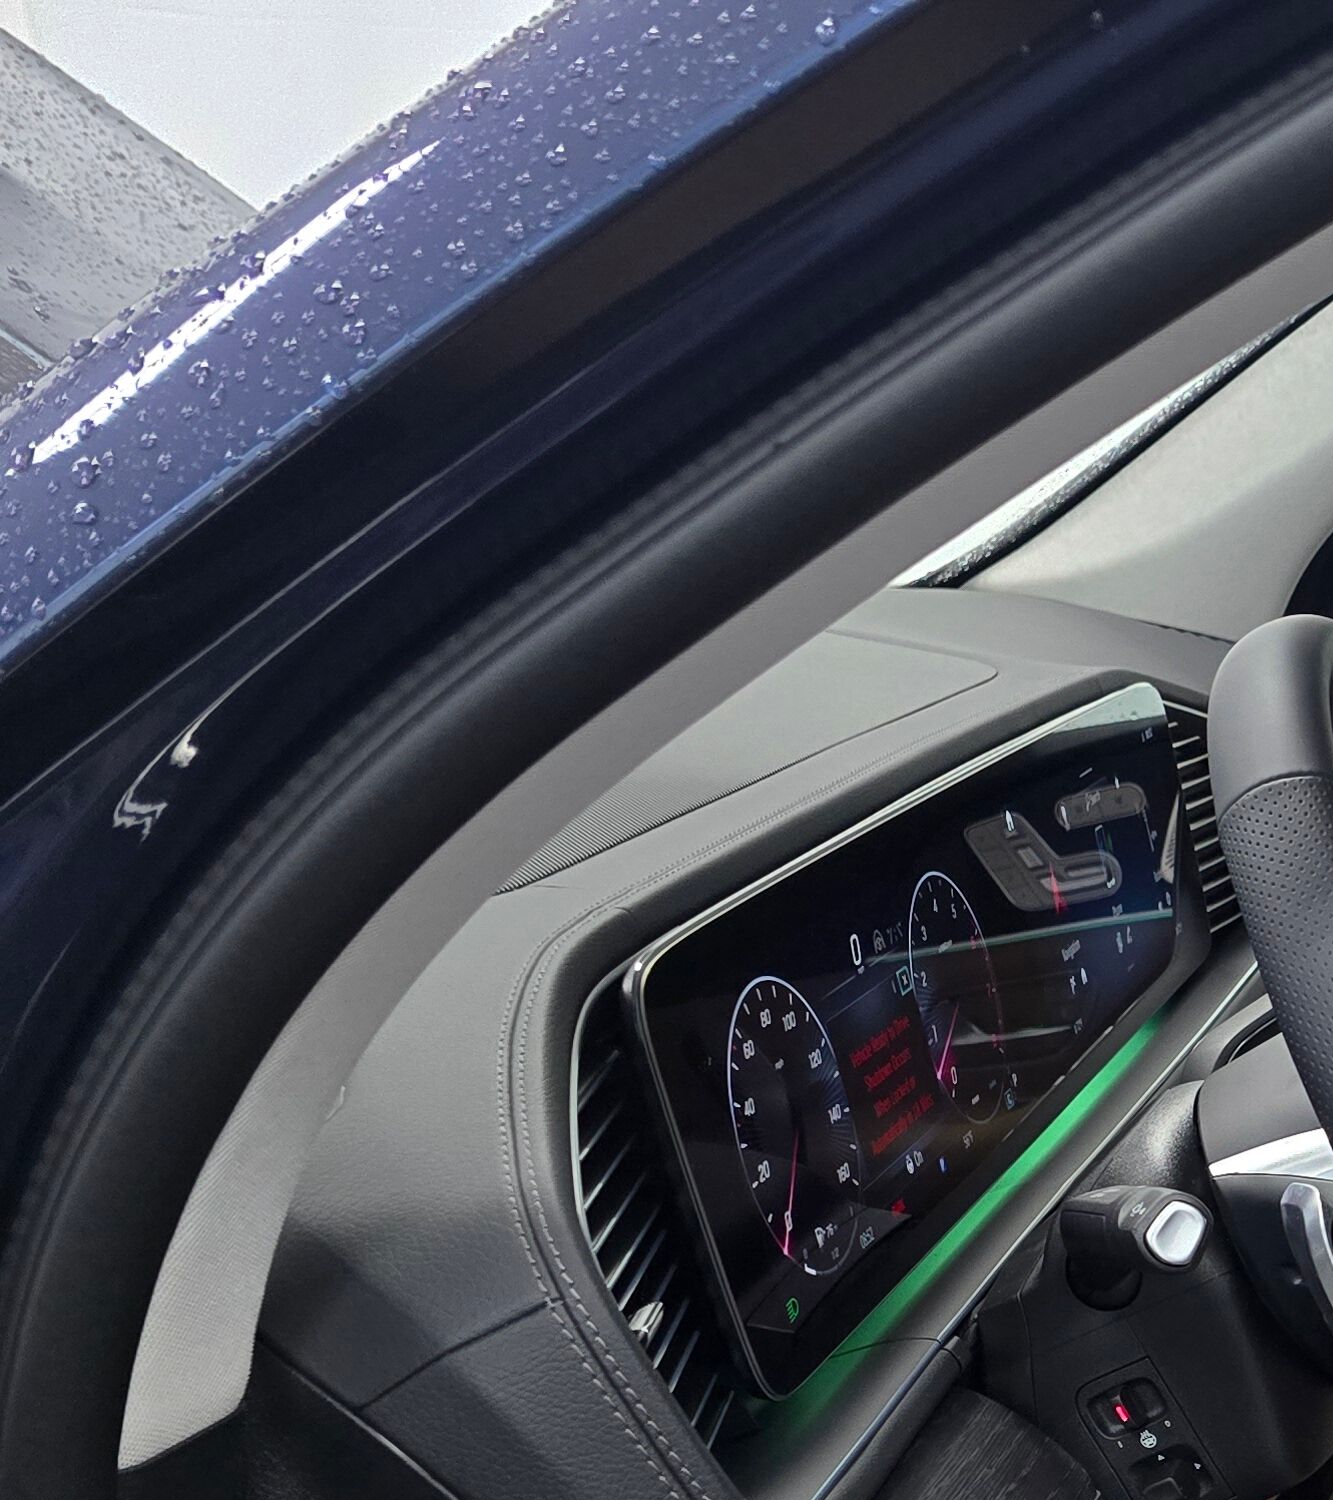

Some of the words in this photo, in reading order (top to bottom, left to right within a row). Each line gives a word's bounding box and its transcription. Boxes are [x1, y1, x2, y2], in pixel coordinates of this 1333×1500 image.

[850, 933, 861, 966] 0
[760, 1008, 771, 1028] 80
[783, 1011, 796, 1032] 100
[743, 1039, 755, 1060] 60
[808, 1048, 823, 1069] 120
[744, 1097, 755, 1116] 40
[828, 1103, 842, 1125] 140
[758, 1160, 771, 1184] 20
[836, 1161, 851, 1184] 160
